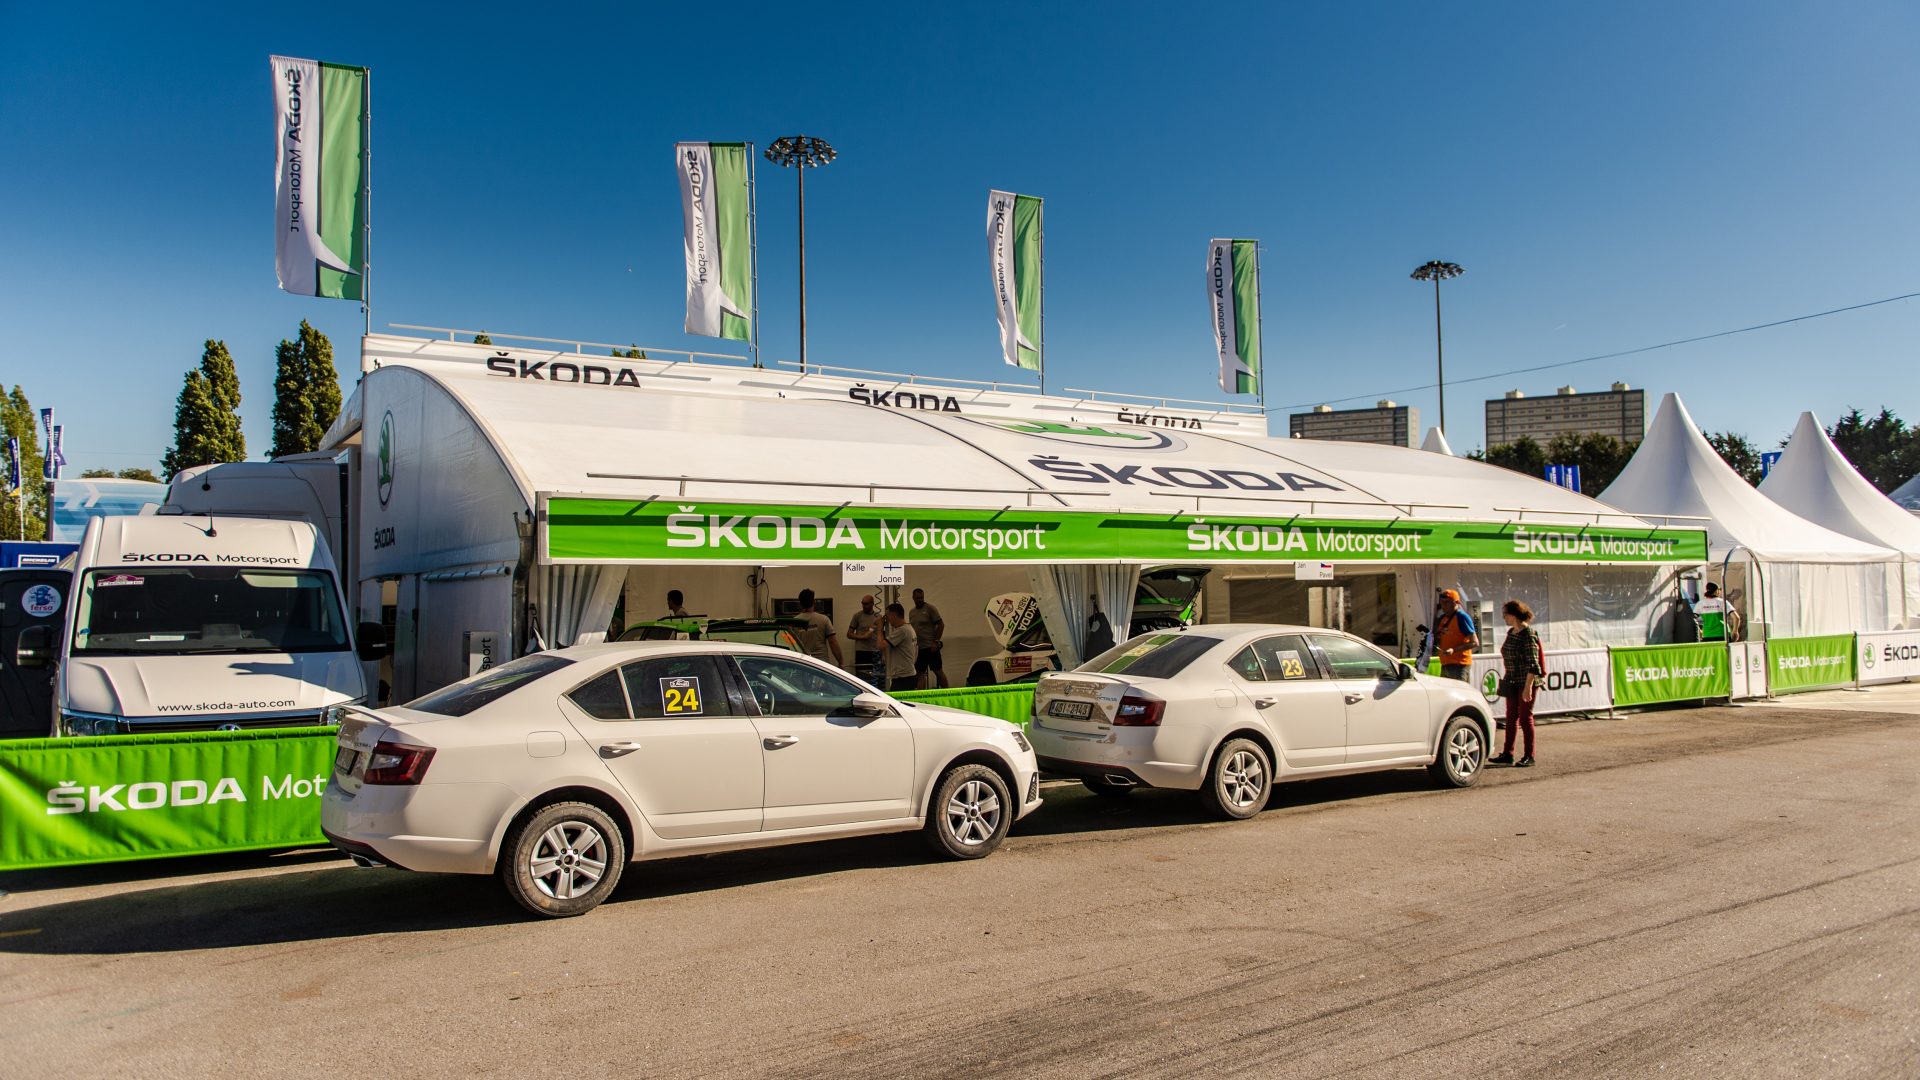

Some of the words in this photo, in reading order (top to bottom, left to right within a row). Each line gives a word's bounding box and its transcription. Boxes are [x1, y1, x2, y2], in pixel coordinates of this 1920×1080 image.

[487, 351, 641, 388] ŠKODA
[849, 382, 961, 413] ŠKODA
[1027, 454, 1347, 492] ŠKODA
[666, 505, 866, 549] ŠKODA
[880, 518, 1046, 558] Motorsport
[1187, 517, 1308, 551] ŠKODA
[1316, 527, 1422, 558] Motorsport
[1513, 525, 1596, 555] ŠKODA
[1600, 534, 1674, 561] Motorsport
[122, 552, 210, 563] ŠKODA
[216, 554, 300, 565] Motorsport
[846, 563, 866, 571] Kalle
[878, 575, 902, 583] Jonne
[481, 637, 493, 670] sport
[1884, 644, 1920, 661] ŠKOD
[1282, 659, 1303, 676] 23
[1625, 666, 1669, 683] ŠKODA
[1671, 664, 1715, 680] Motorsport
[1540, 670, 1592, 691] ODA
[157, 698, 296, 712] www.skoda-auto.com
[665, 688, 699, 711] 24
[46, 777, 248, 815] ŠKODA
